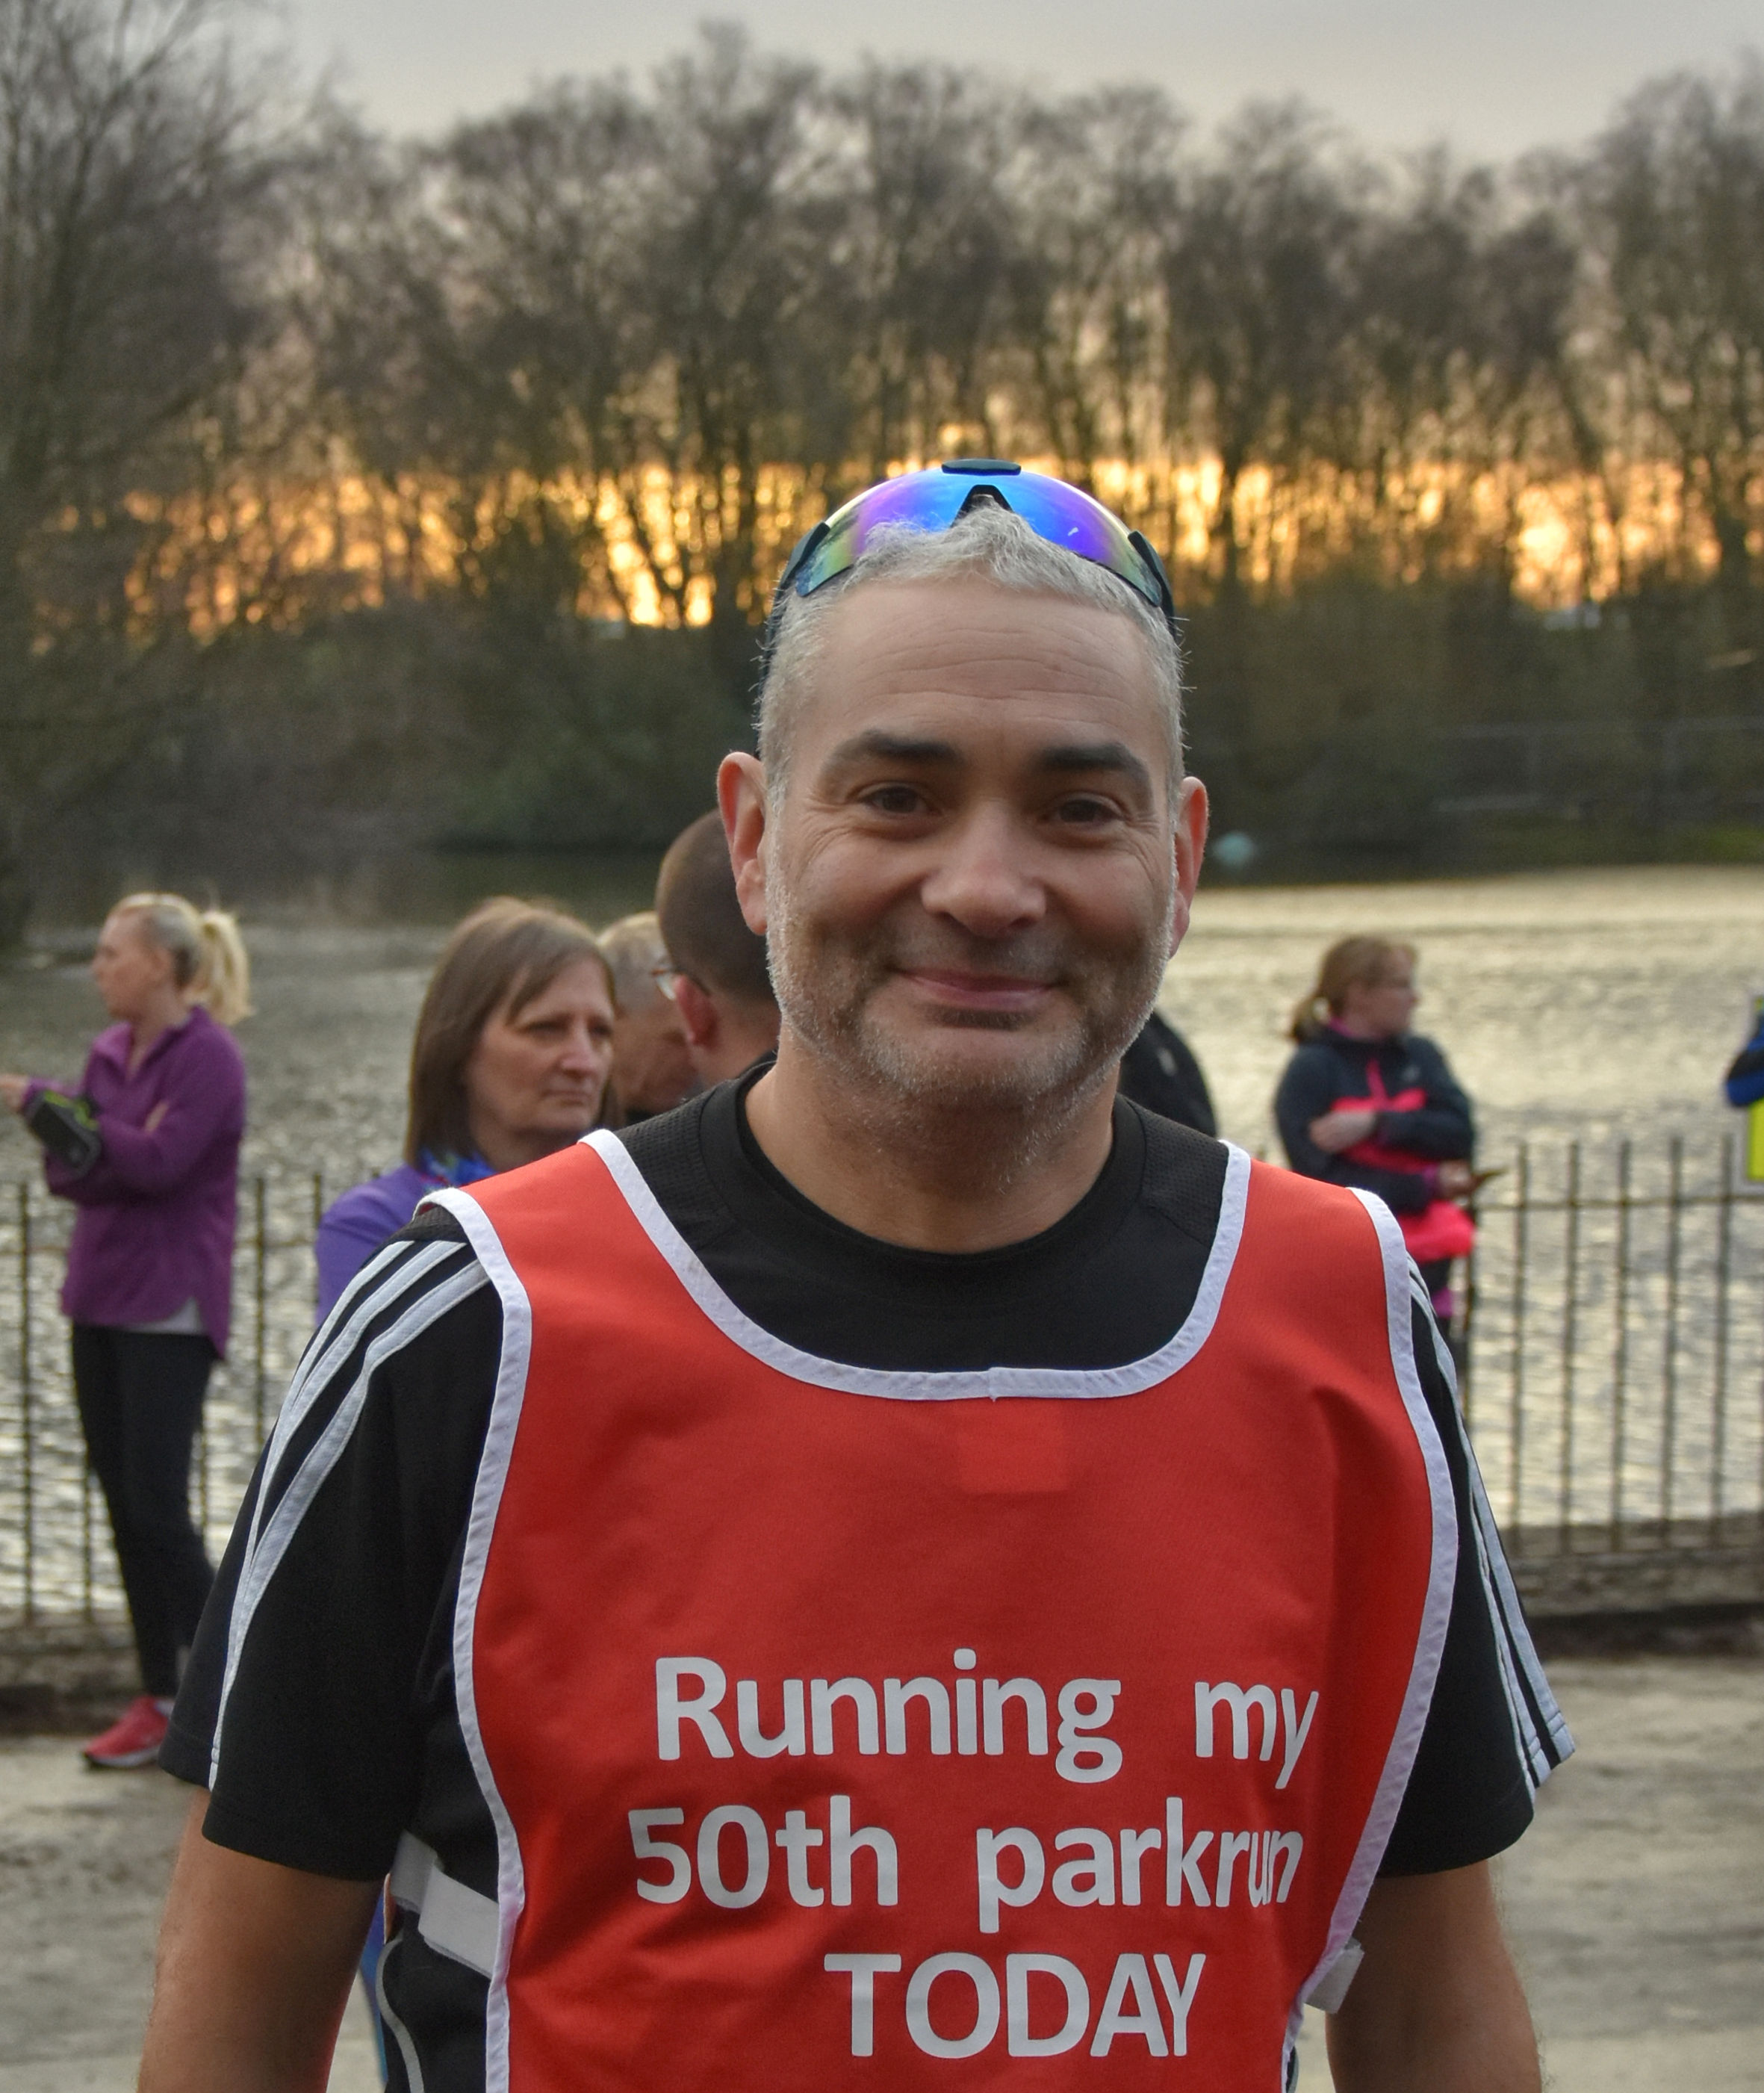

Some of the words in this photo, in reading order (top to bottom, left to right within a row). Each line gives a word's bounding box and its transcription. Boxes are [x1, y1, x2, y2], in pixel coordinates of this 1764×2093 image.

[656, 1649, 1122, 1783] Running
[1195, 1681, 1318, 1788] my
[629, 1795, 898, 1908] 50th
[977, 1797, 1302, 1933] parkrun
[824, 1953, 1205, 2059] TODAY
